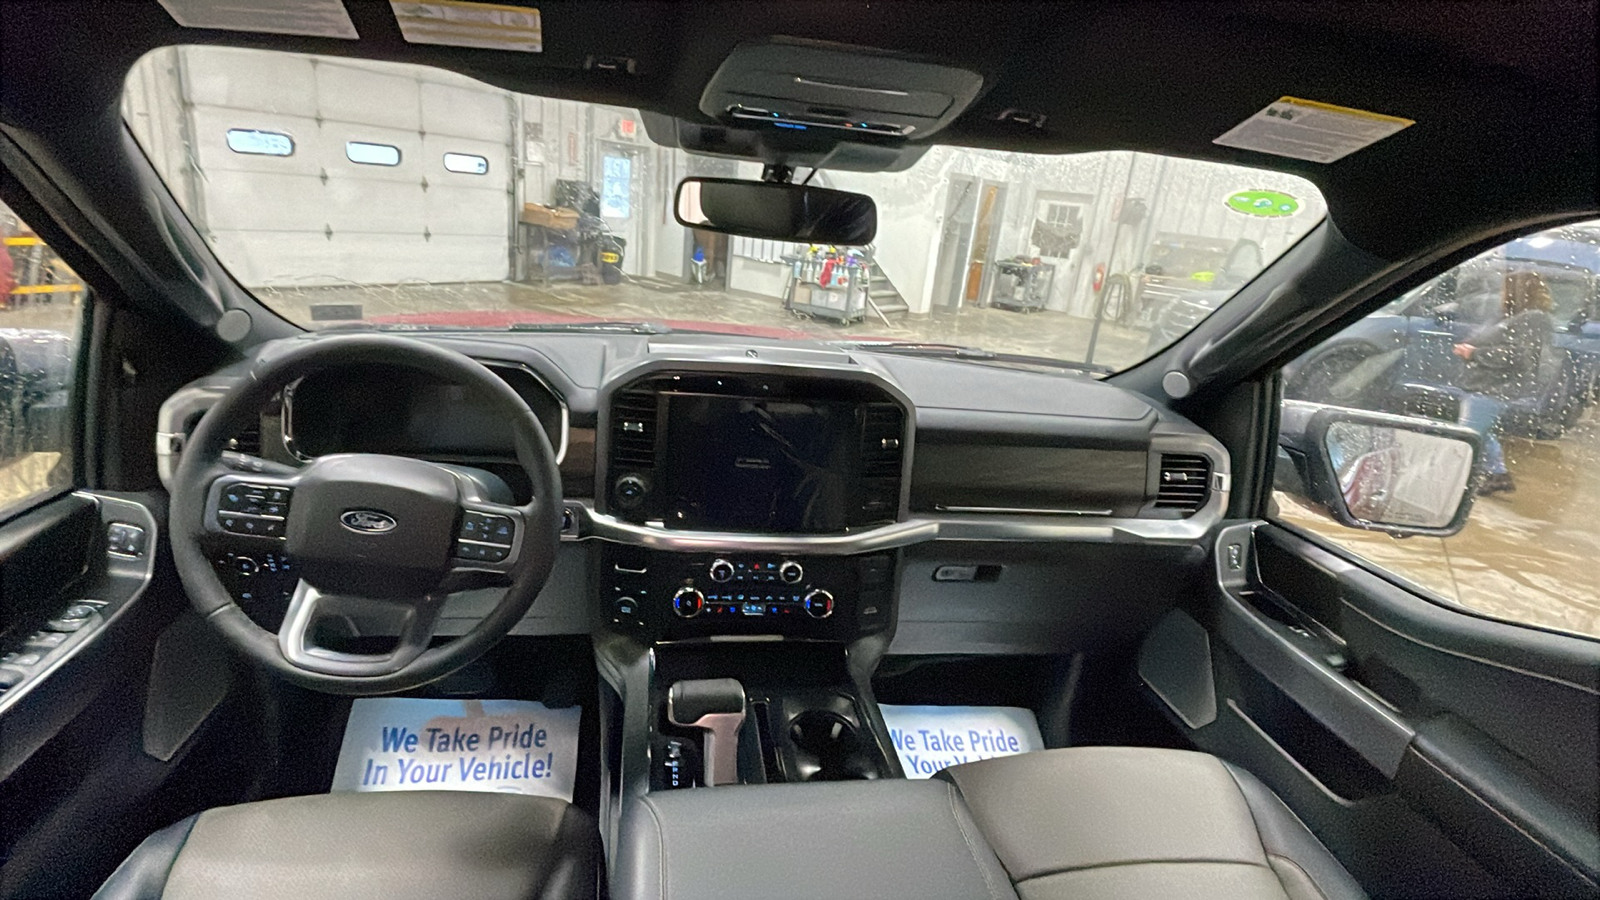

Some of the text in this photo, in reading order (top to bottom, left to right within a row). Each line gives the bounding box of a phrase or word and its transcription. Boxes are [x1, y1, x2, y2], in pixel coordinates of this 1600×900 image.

[382, 722, 547, 753] We Take Pride
[918, 728, 965, 752] Take
[968, 728, 1019, 752] Pride
[362, 751, 553, 786] In Your Vehicle!
